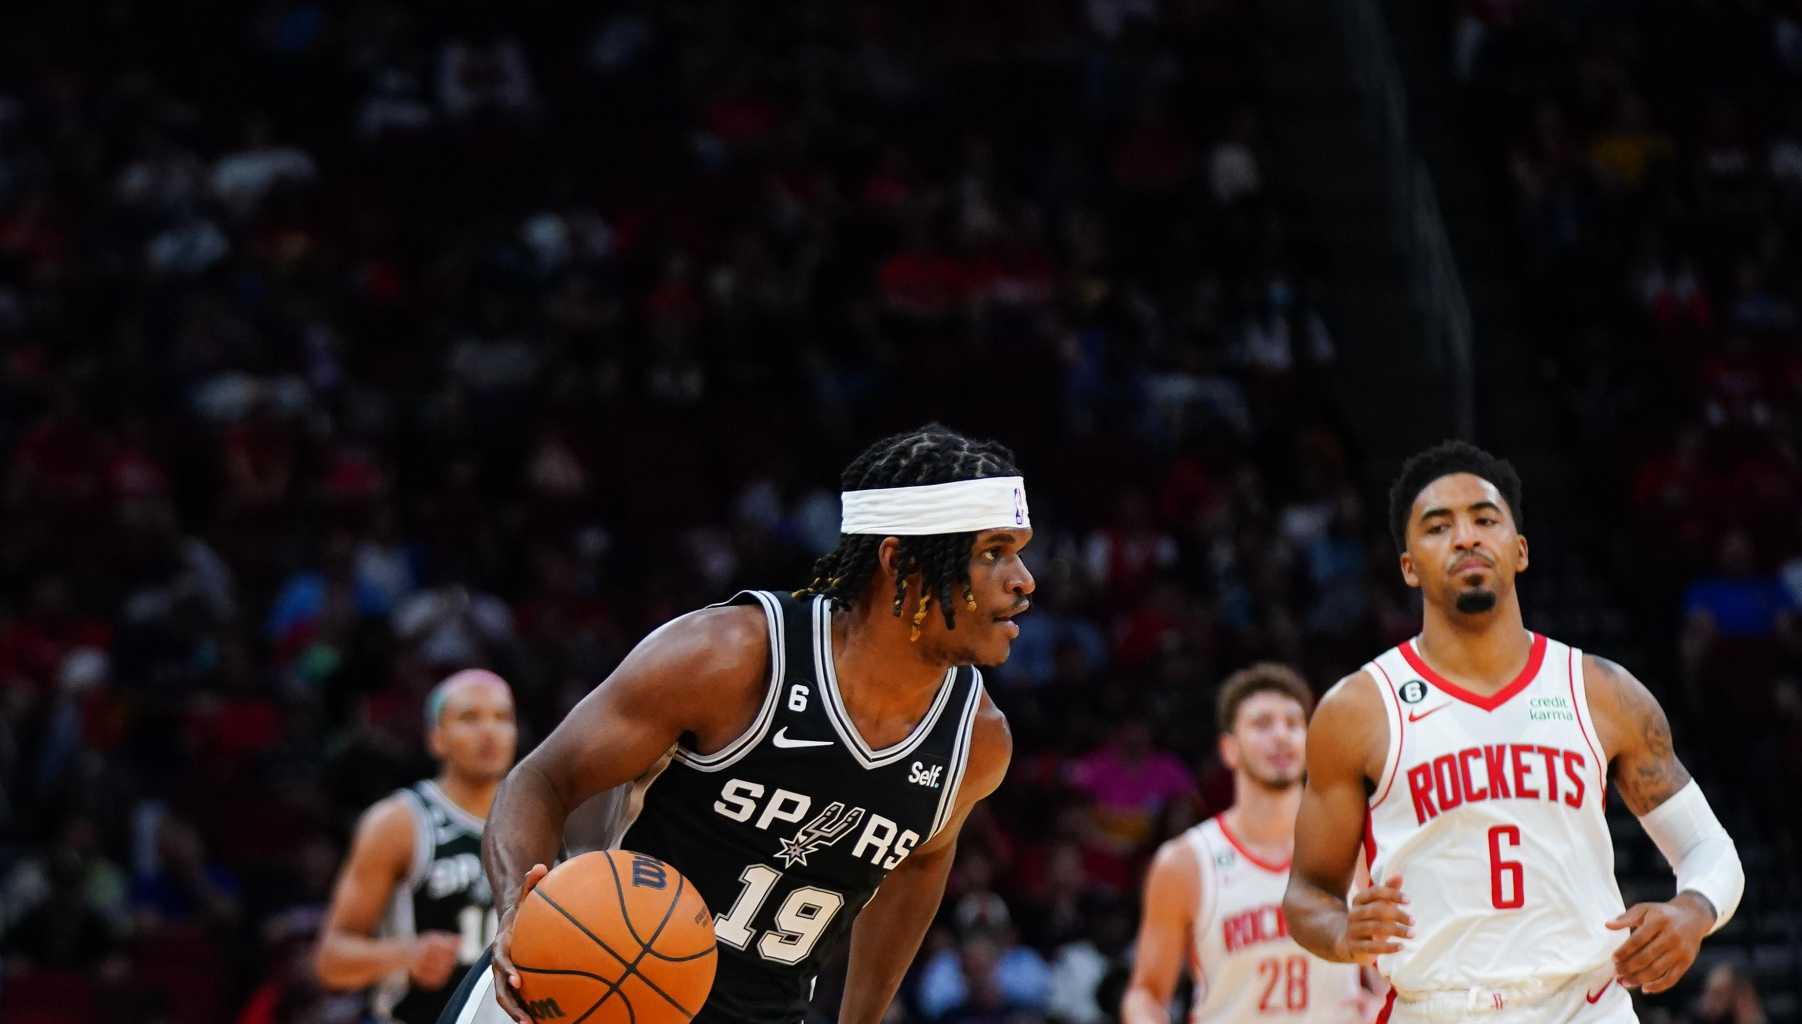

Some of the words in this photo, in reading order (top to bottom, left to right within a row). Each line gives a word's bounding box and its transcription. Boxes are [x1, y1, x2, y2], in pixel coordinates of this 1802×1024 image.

[788, 684, 809, 712] 6
[1529, 709, 1573, 721] karma
[1530, 696, 1568, 709] credit
[1407, 743, 1586, 826] ROCKETS
[1487, 824, 1525, 910] 6
[714, 863, 845, 966] 19
[1257, 956, 1309, 1016] 28
